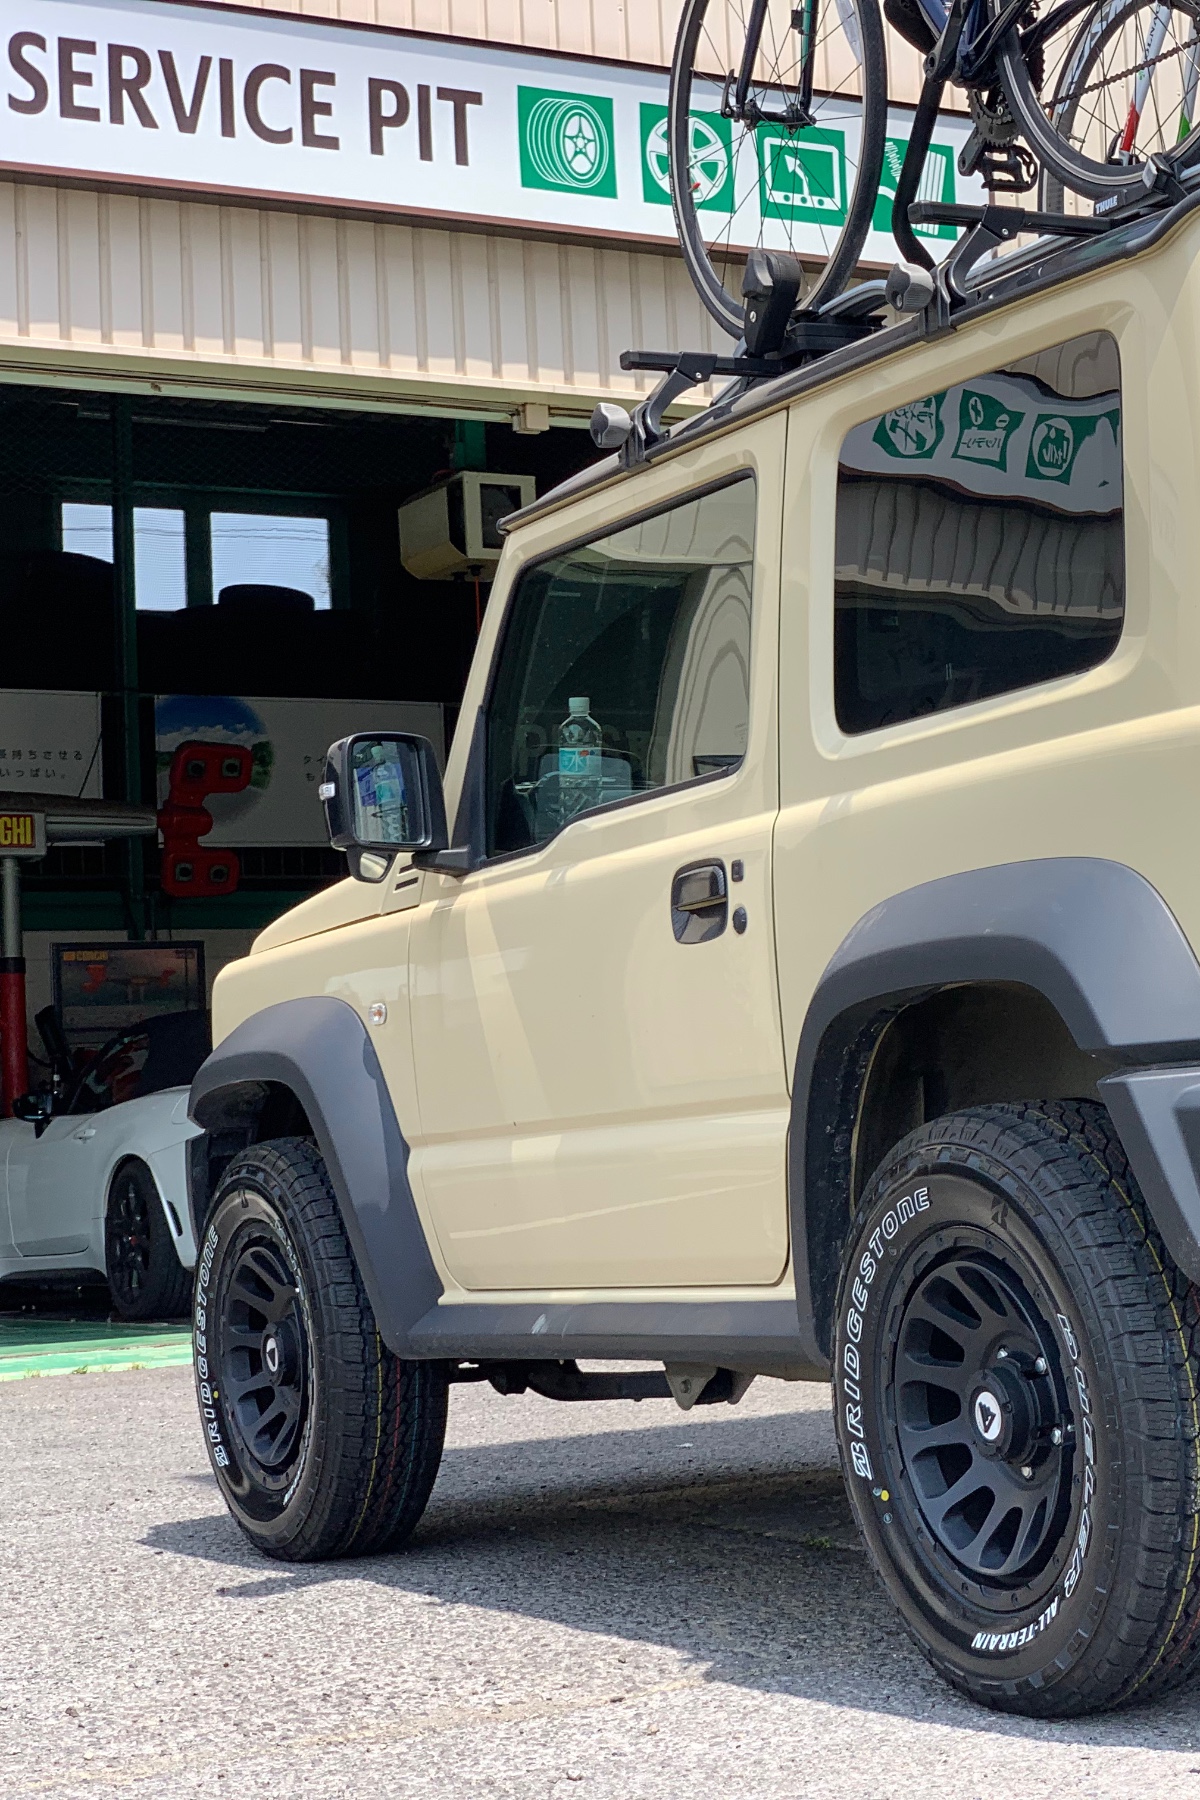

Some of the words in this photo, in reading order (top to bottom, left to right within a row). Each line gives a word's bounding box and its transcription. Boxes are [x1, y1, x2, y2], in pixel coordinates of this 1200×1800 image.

[7, 30, 341, 151] SERVICE
[368, 76, 484, 167] PIT
[1095, 194, 1118, 215] THULE
[196, 1224, 229, 1468] BRIDGESTONE
[842, 1185, 931, 1481] BRIDGESTONE
